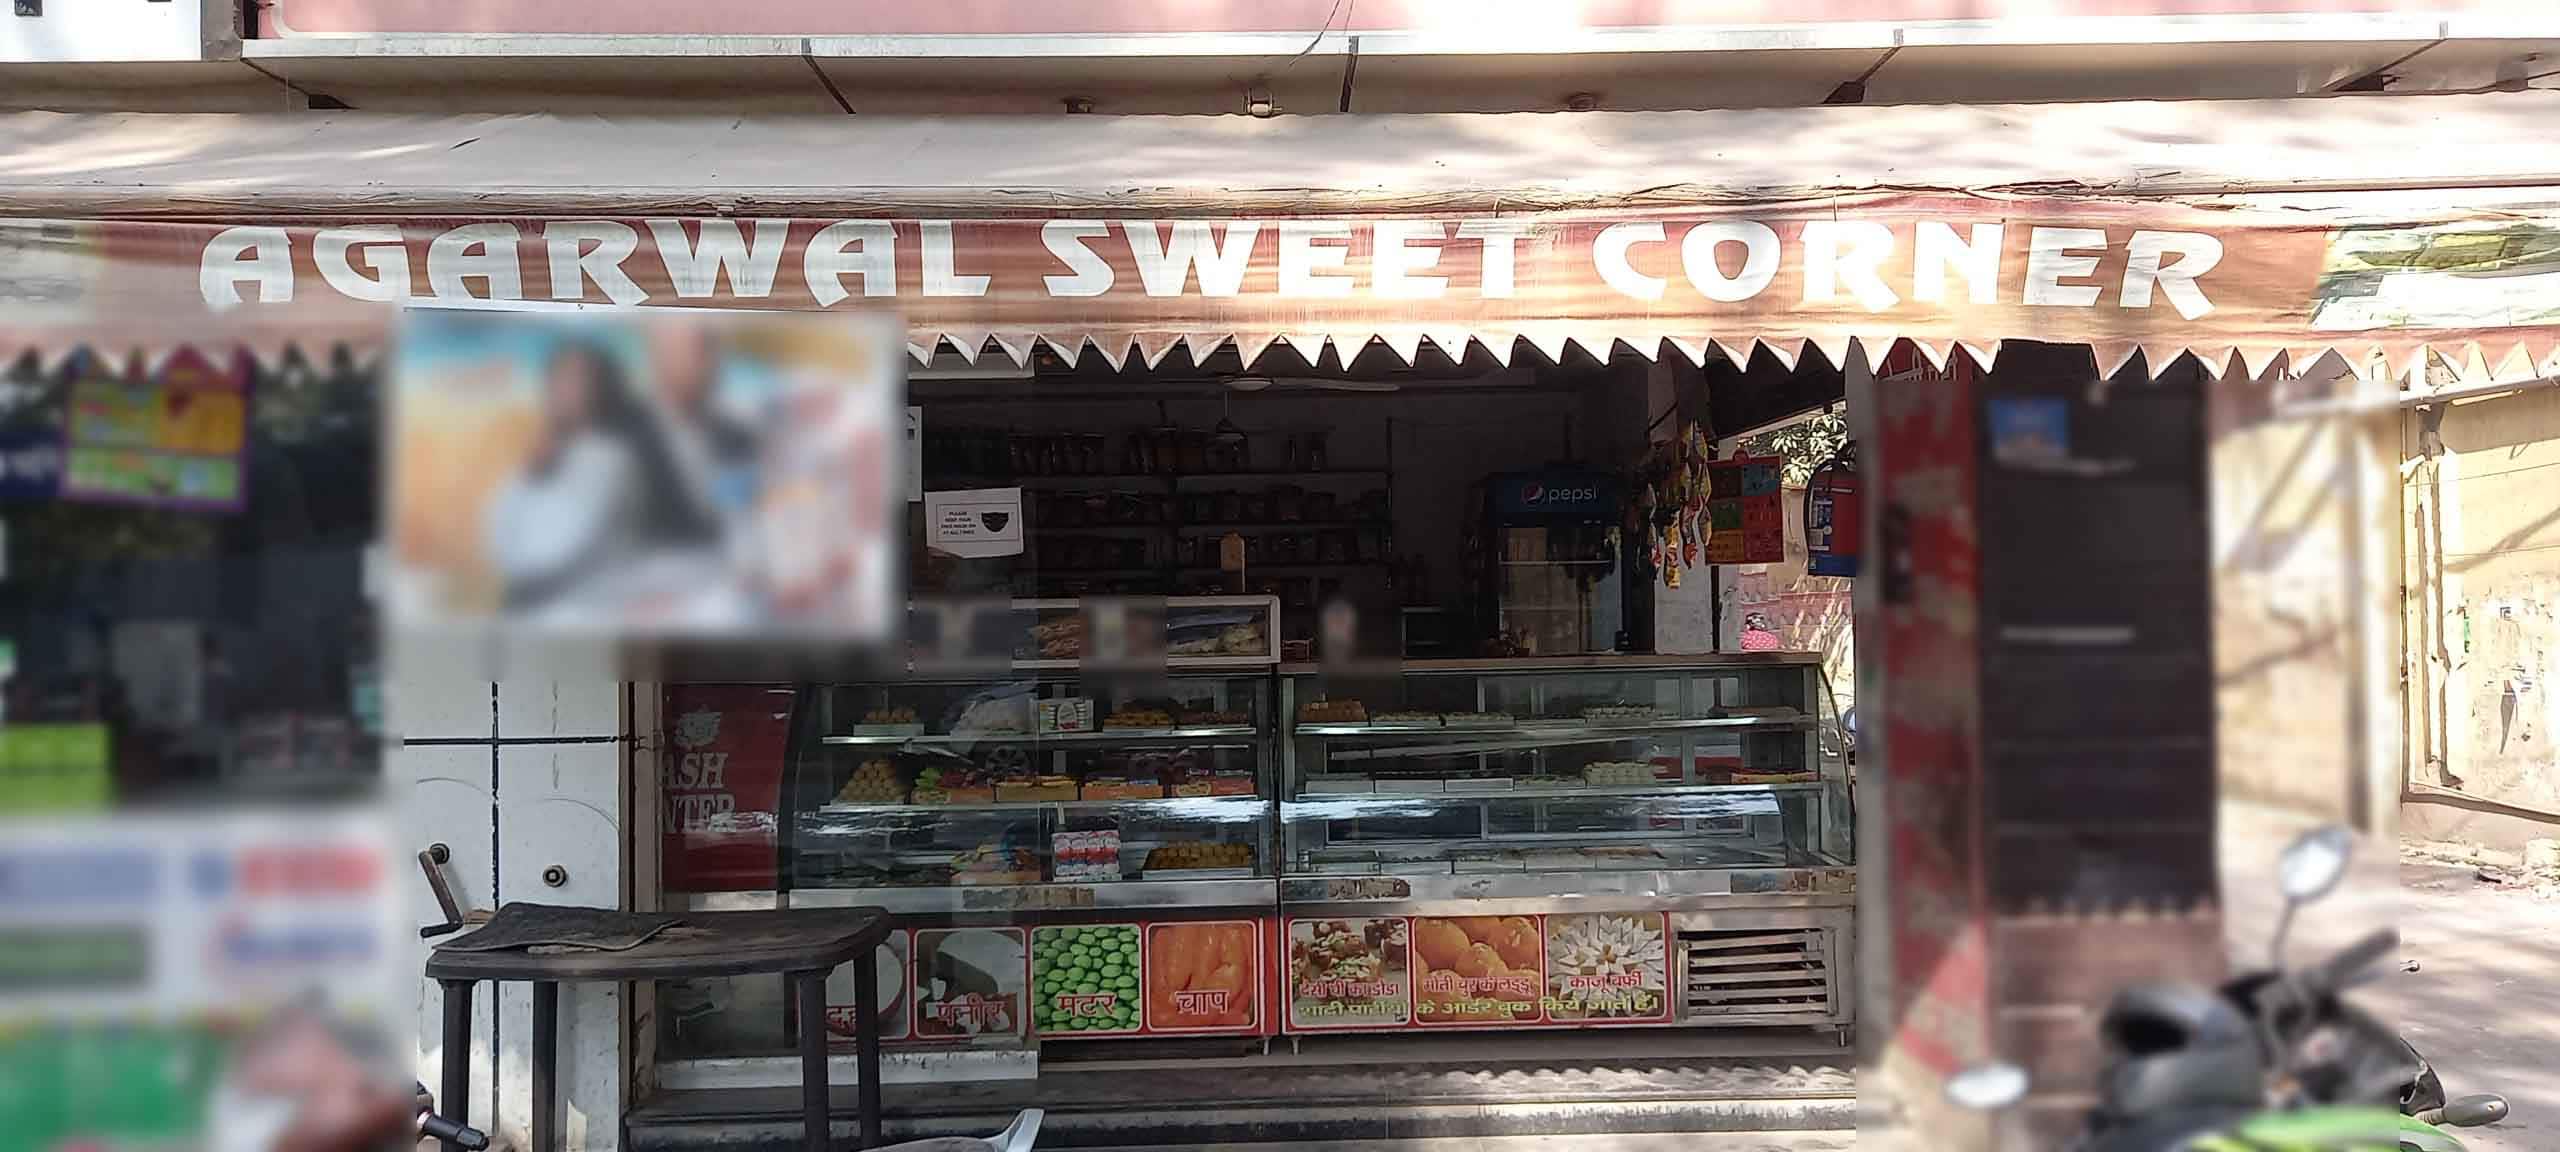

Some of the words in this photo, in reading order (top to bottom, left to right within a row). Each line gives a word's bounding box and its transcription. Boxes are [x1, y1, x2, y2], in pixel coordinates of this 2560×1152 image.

[200, 219, 992, 309] AGARWAL
[1040, 219, 1538, 299] SWEET
[1592, 220, 2224, 321] CORNER
[1548, 483, 1598, 504] pepsi
[658, 752, 728, 789] ASH
[662, 793, 736, 834] NTER
[1568, 975, 1609, 993] काजू
[1056, 993, 1118, 1019] मटर
[1175, 990, 1231, 1015] चाप
[1416, 999, 1436, 1015] के
